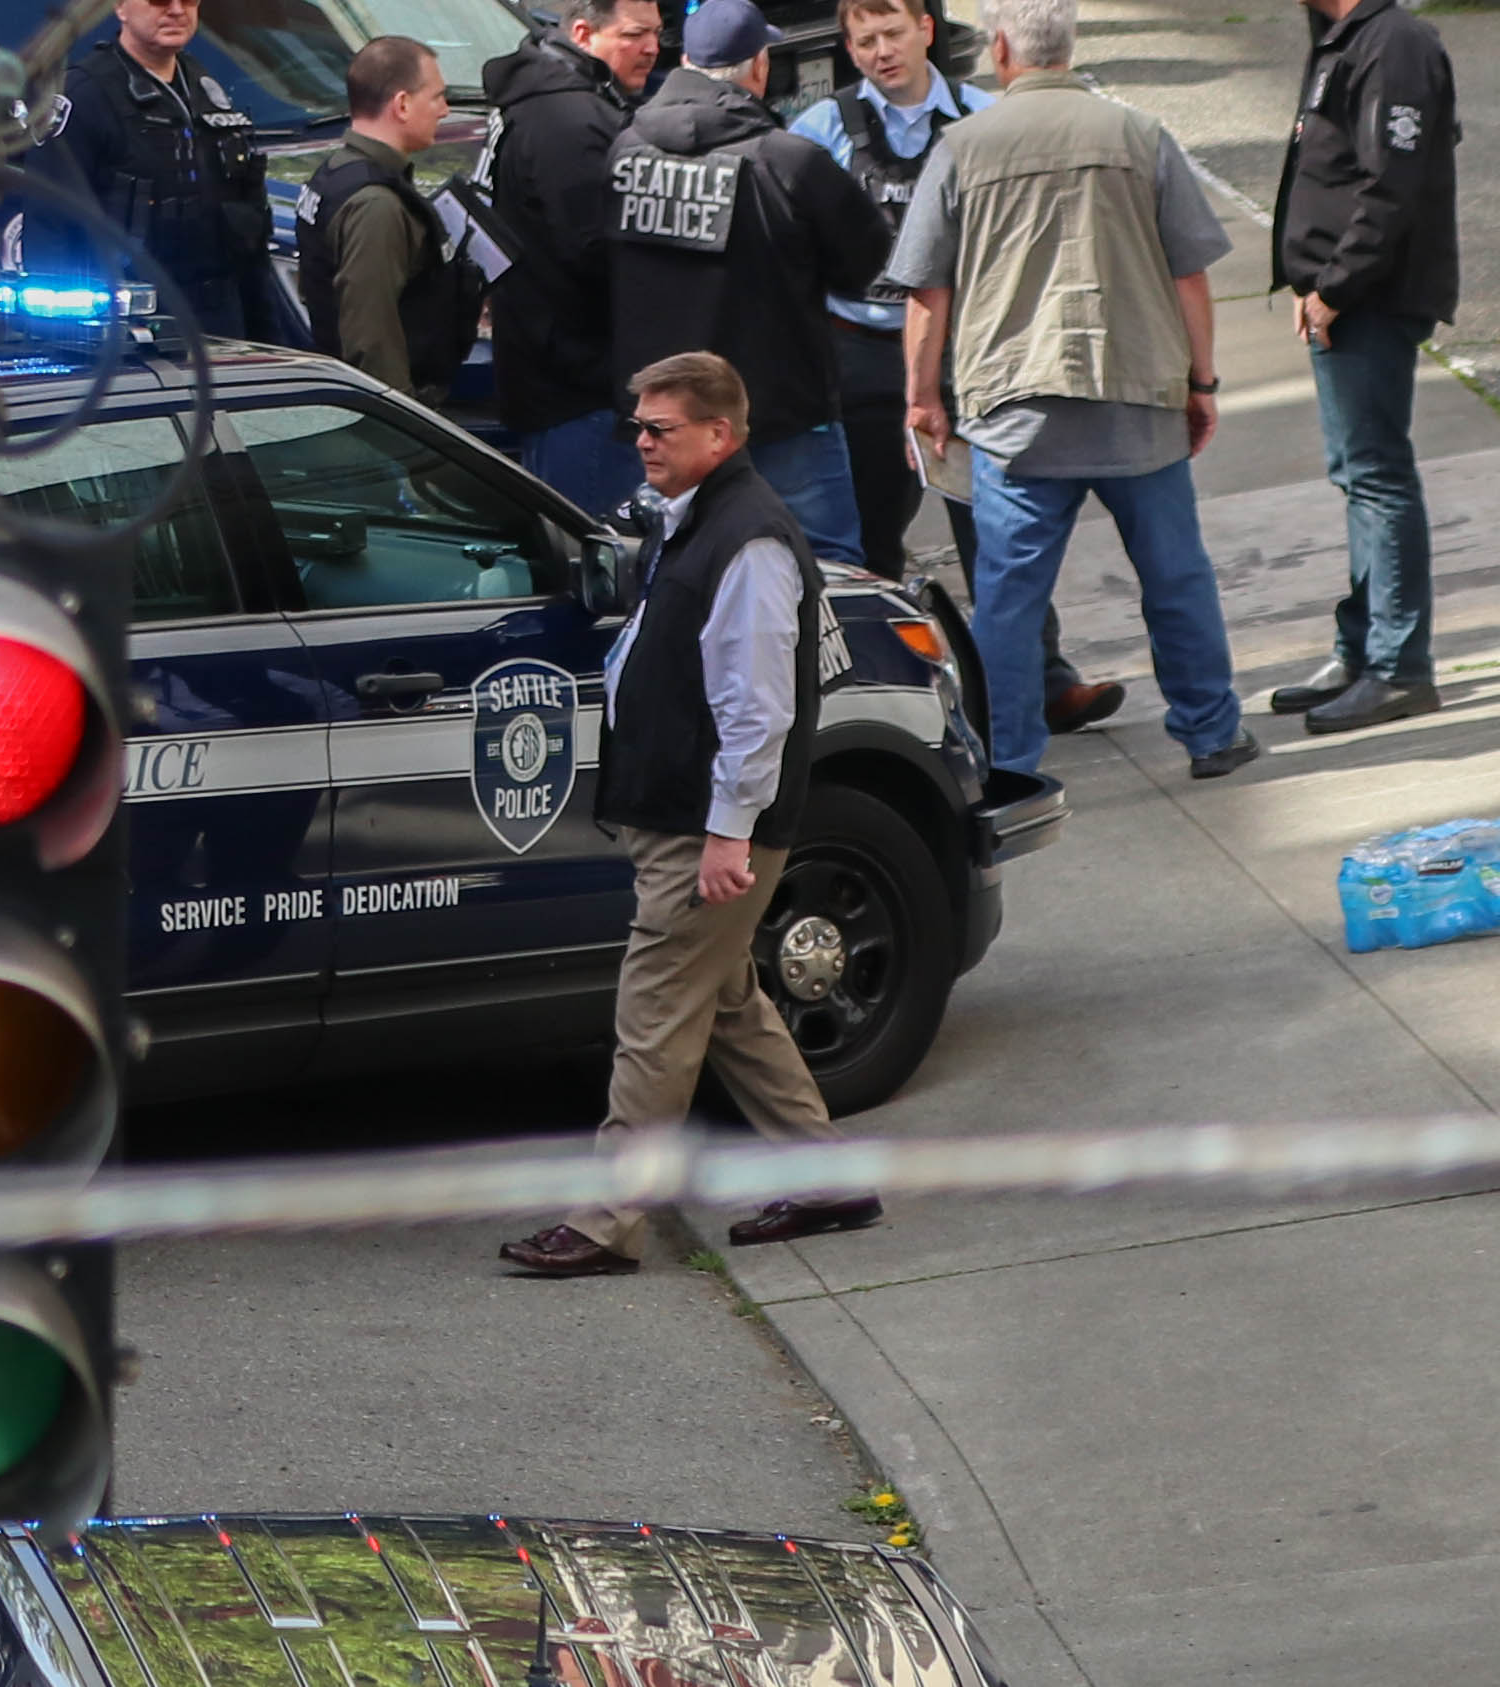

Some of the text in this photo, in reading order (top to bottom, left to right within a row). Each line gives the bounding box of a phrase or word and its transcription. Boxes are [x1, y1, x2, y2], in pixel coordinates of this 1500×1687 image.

[612, 157, 735, 204] SEATTLE
[620, 194, 720, 242] POLICE
[488, 673, 564, 713] SEATTLE
[129, 742, 209, 793] ICE
[494, 784, 553, 821] POLICE
[161, 878, 461, 934] SERVICE PRIDE DEDICATION
